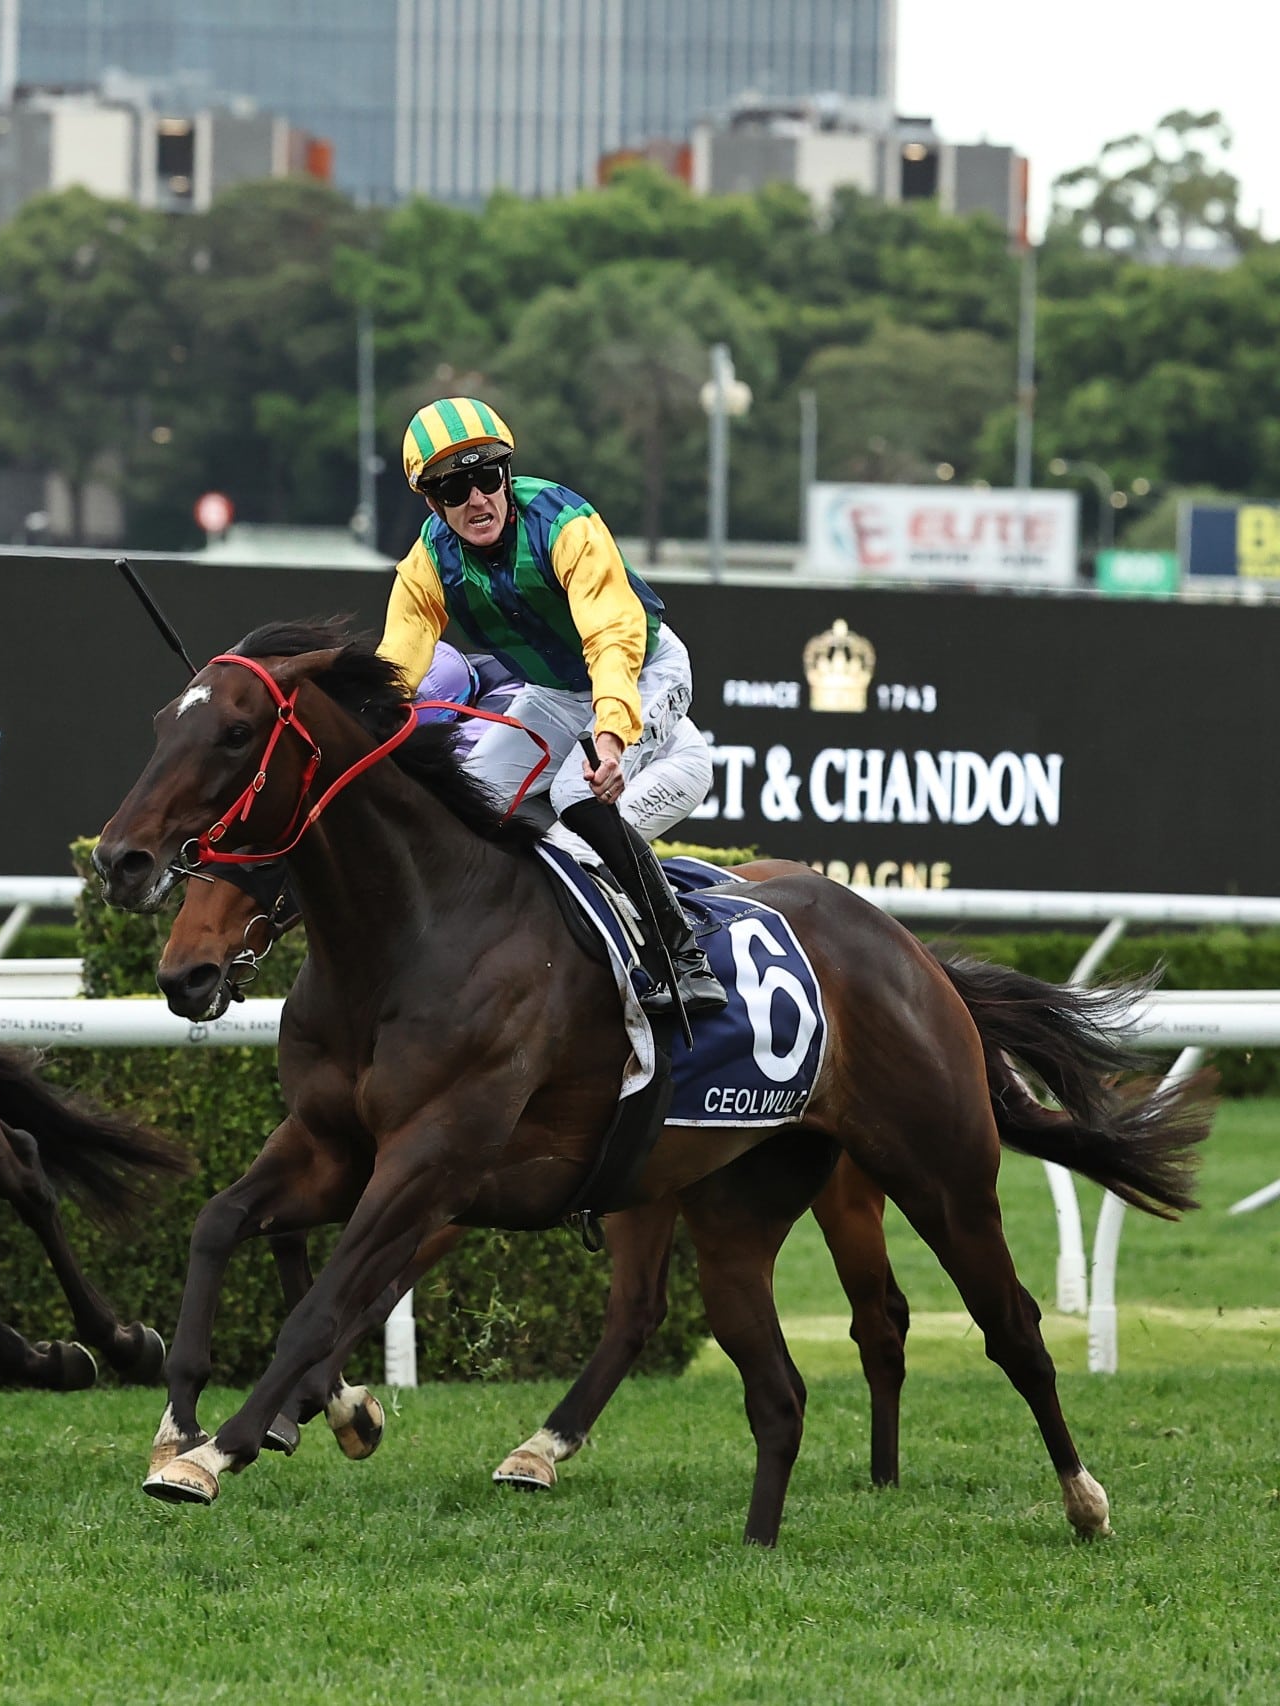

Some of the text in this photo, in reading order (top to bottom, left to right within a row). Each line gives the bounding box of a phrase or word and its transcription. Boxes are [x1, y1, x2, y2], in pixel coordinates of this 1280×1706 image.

[723, 680, 800, 708] FRANCE
[628, 783, 670, 817] NASH
[761, 744, 803, 822] &
[810, 747, 1064, 826] CHANDON
[811, 860, 952, 889] PAGNE
[728, 918, 818, 1082] 6
[704, 1087, 808, 1114] CEOLWULF
